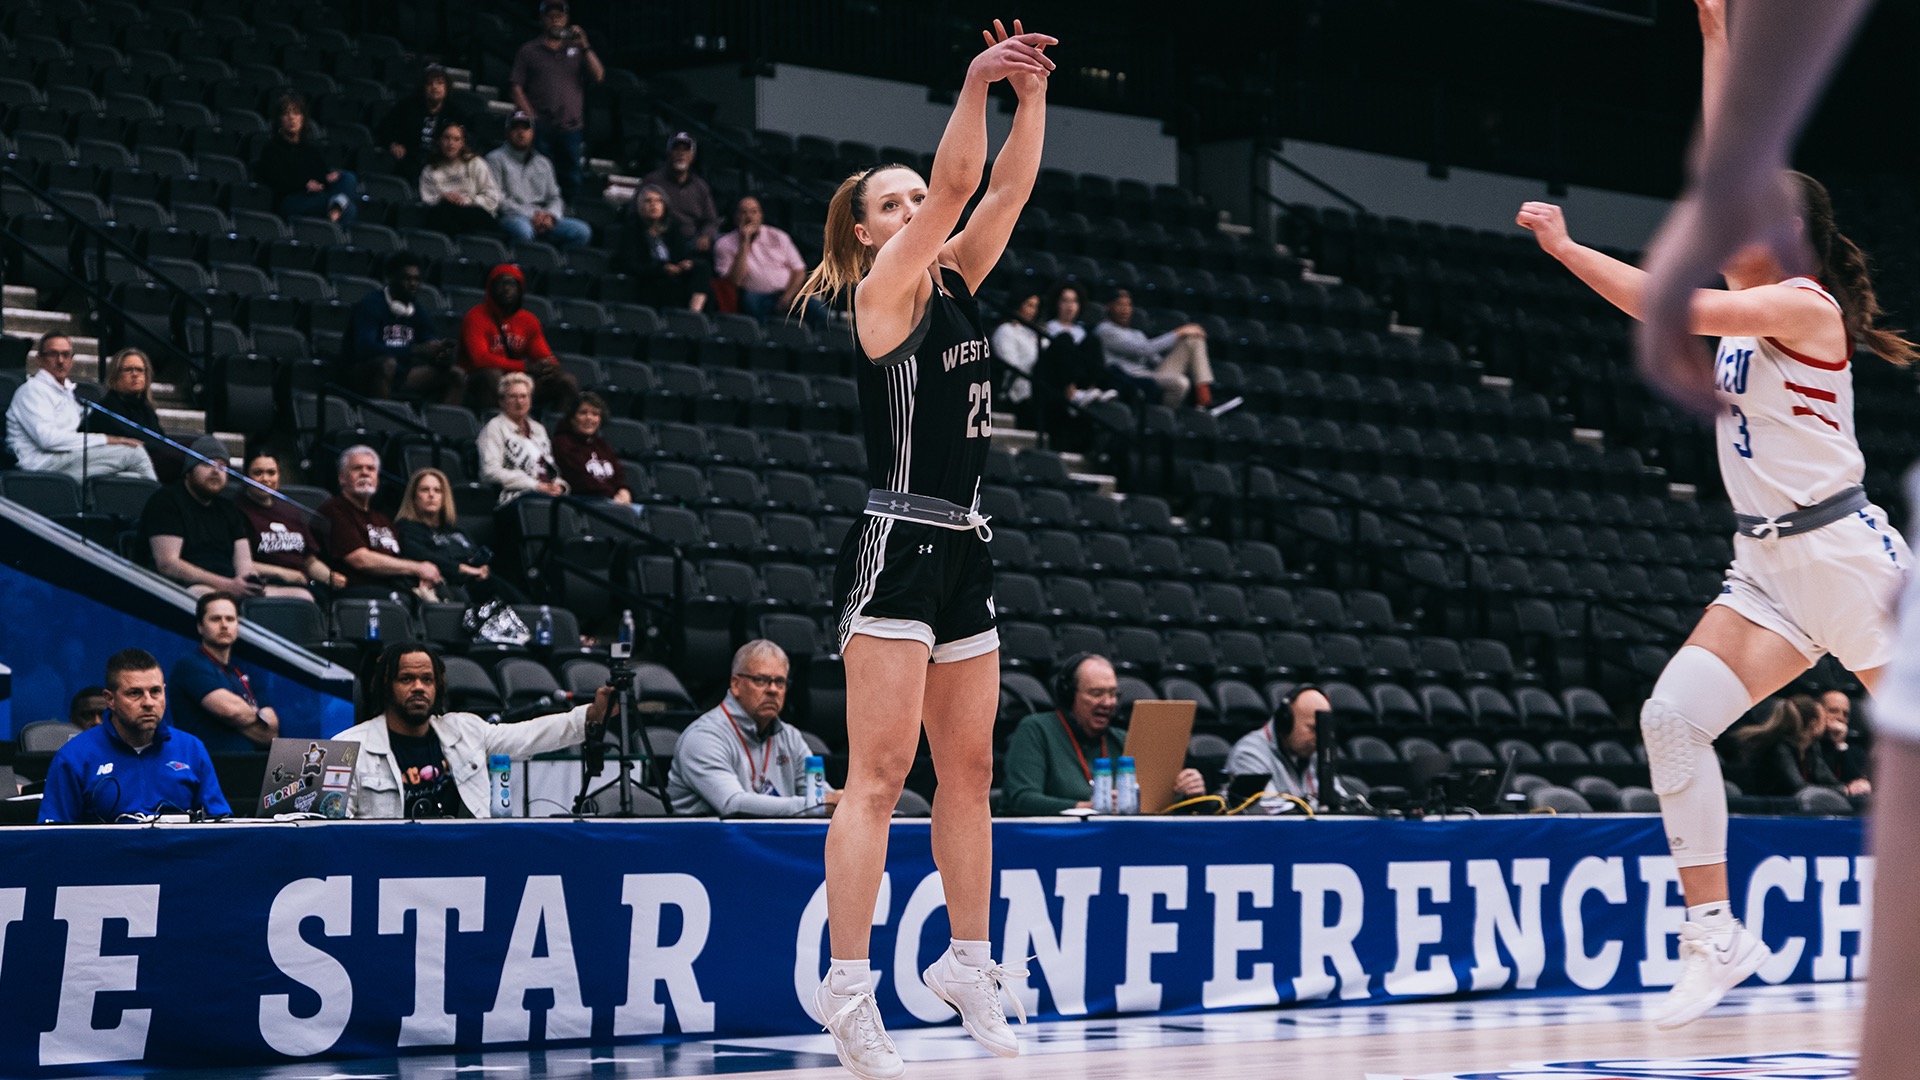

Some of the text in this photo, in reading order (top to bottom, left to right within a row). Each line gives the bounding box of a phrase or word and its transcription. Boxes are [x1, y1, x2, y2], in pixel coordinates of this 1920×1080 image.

[966, 380, 992, 438] 23
[263, 779, 306, 809] FLORIPA
[501, 771, 510, 808] core
[0, 884, 161, 1066] E
[258, 872, 716, 1057] STAR
